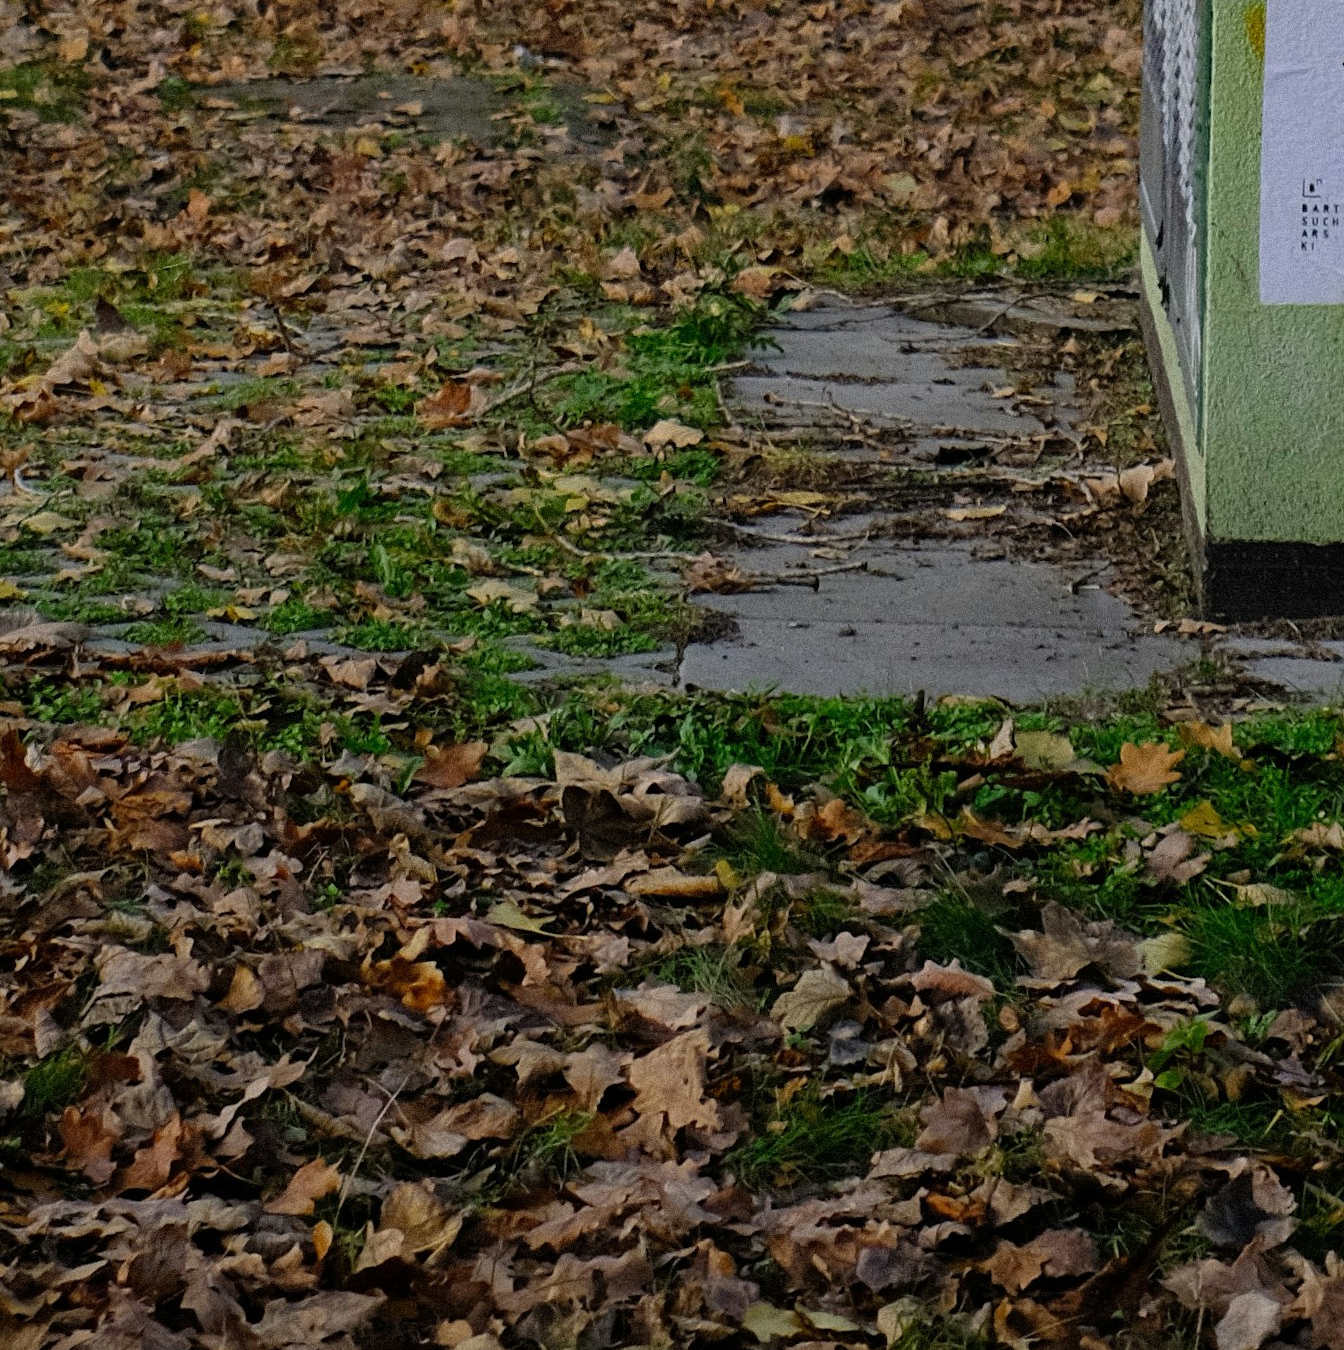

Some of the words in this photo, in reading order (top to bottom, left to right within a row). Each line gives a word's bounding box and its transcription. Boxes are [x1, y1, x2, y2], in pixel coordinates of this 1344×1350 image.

[1302, 203, 1339, 213] BART
[1301, 217, 1339, 227] SUCH
[1301, 229, 1329, 239] ARS
